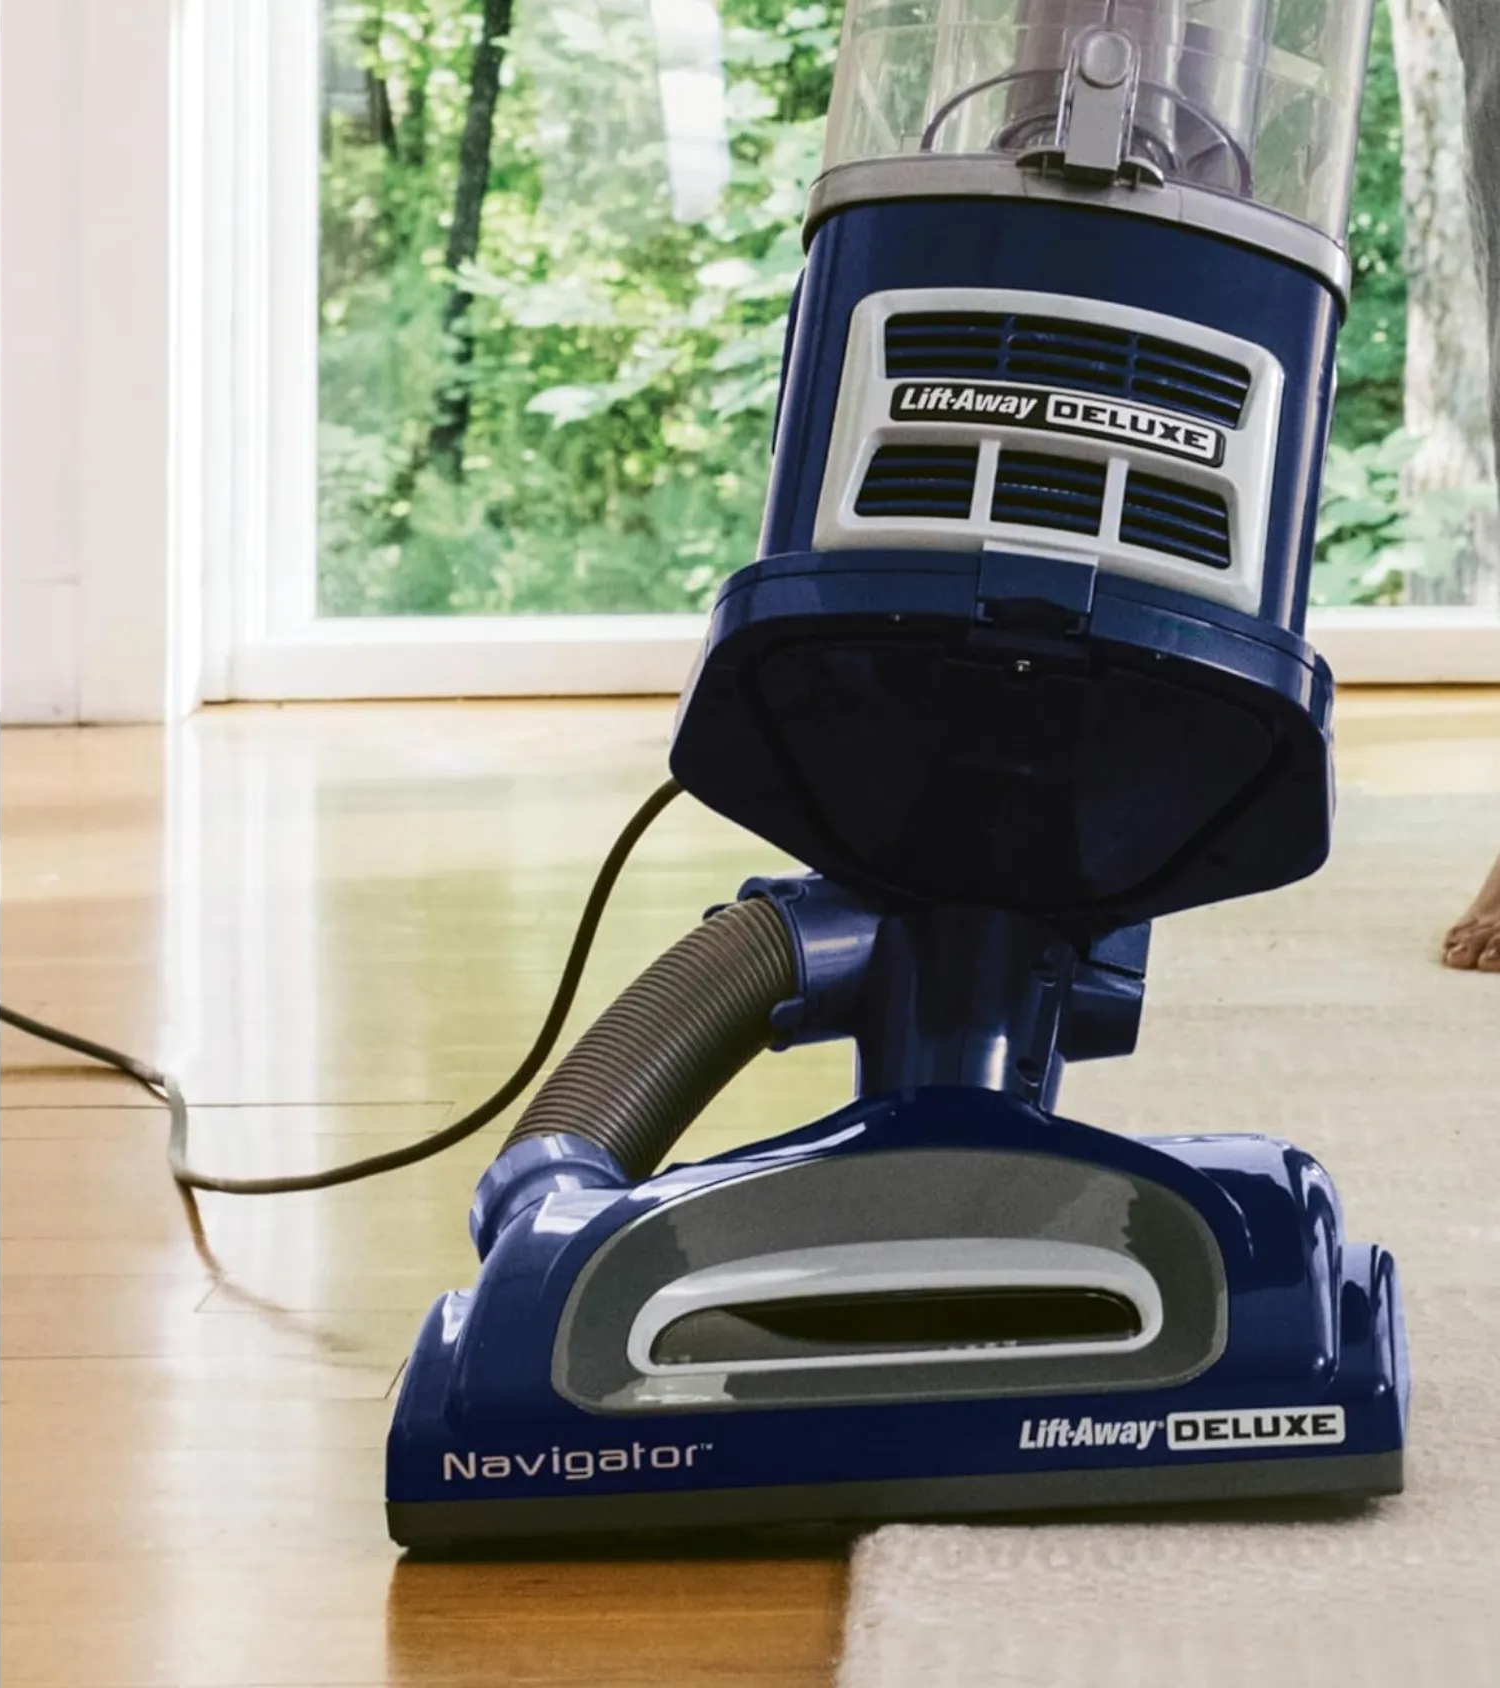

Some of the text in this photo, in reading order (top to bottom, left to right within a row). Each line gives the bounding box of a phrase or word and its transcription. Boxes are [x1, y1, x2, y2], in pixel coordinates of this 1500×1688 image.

[900, 387, 1210, 451] Lift-Away DELUXE
[1018, 1412, 1338, 1450] Lift-Away DELUXE
